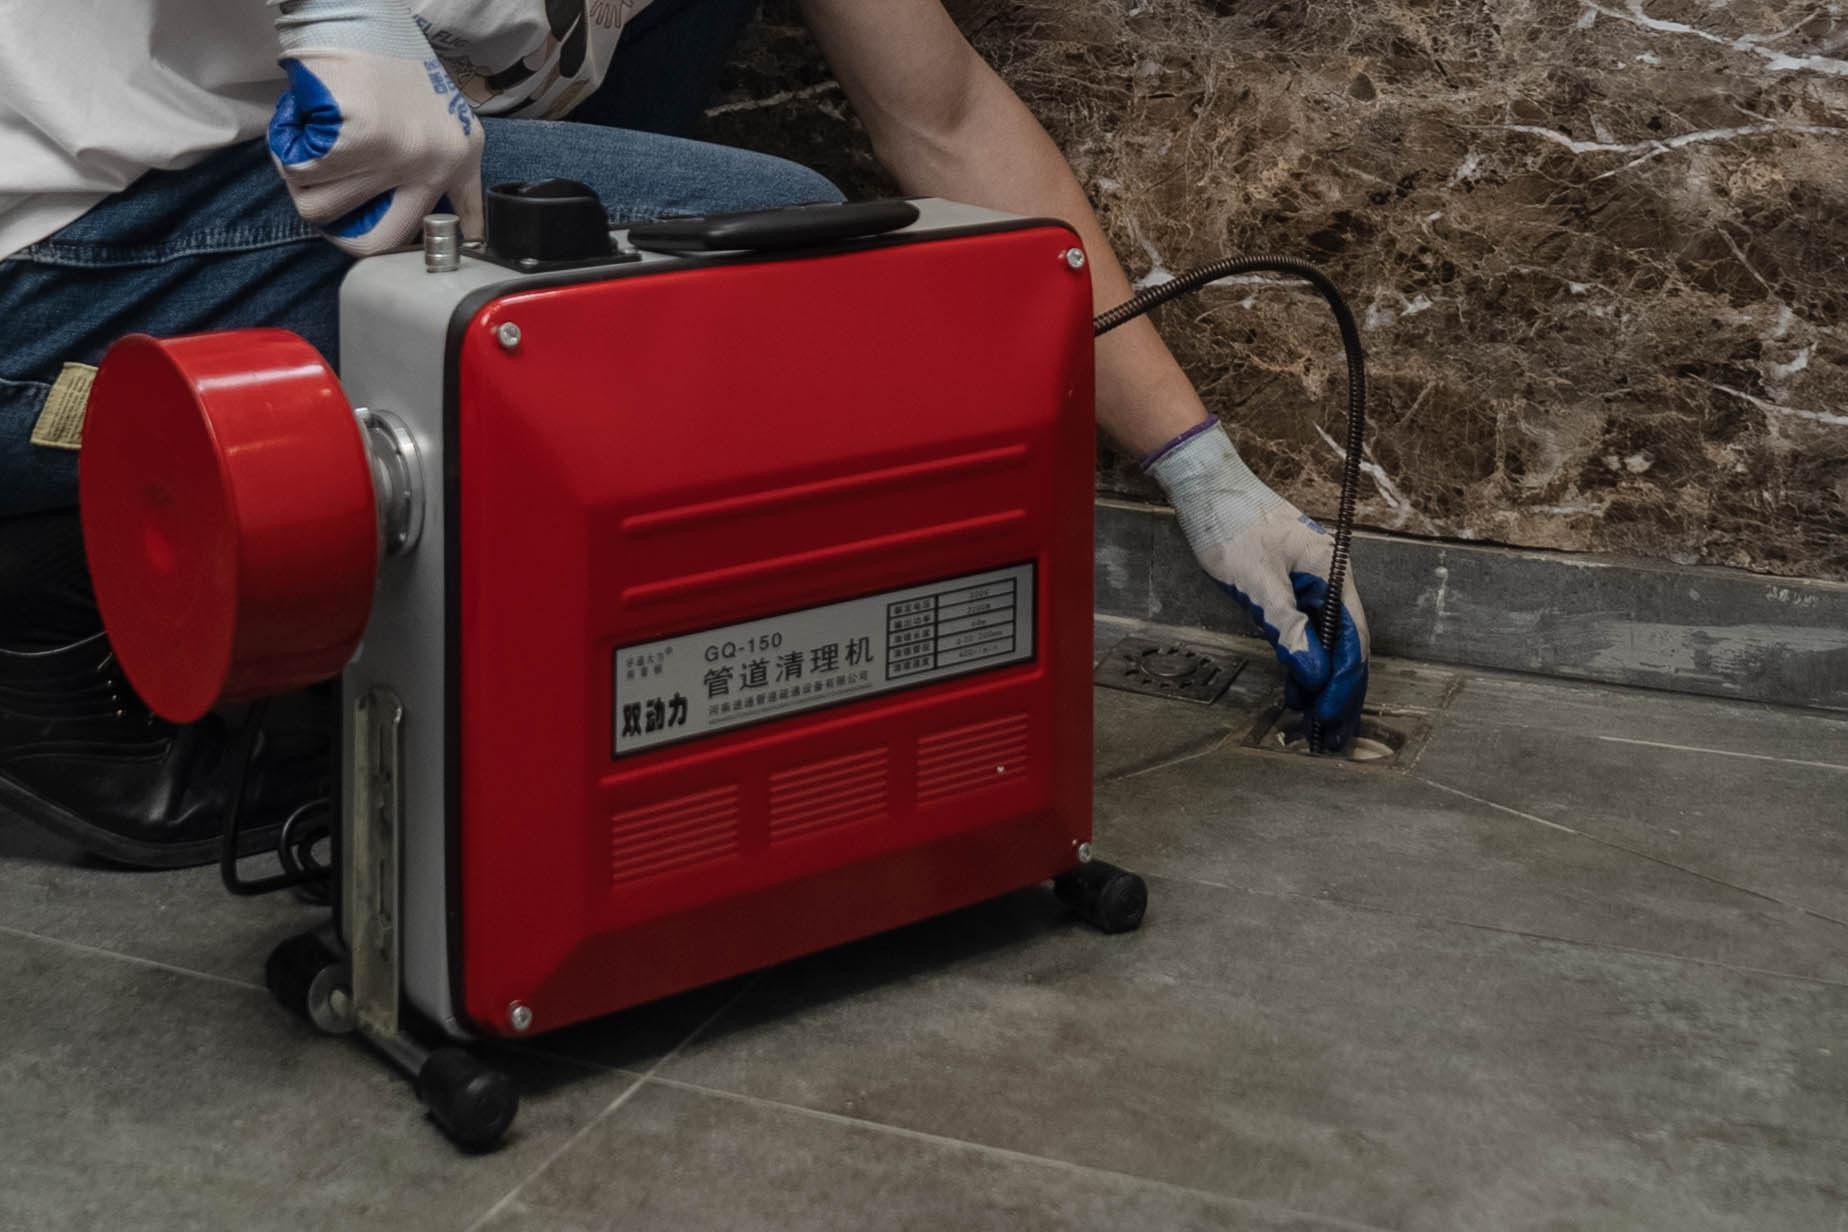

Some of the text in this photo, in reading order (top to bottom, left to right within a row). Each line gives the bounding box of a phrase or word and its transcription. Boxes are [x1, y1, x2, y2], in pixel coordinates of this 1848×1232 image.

[703, 636, 874, 699] 管道清理机
[704, 632, 783, 662] GQ-150
[621, 691, 688, 738] 双动力
